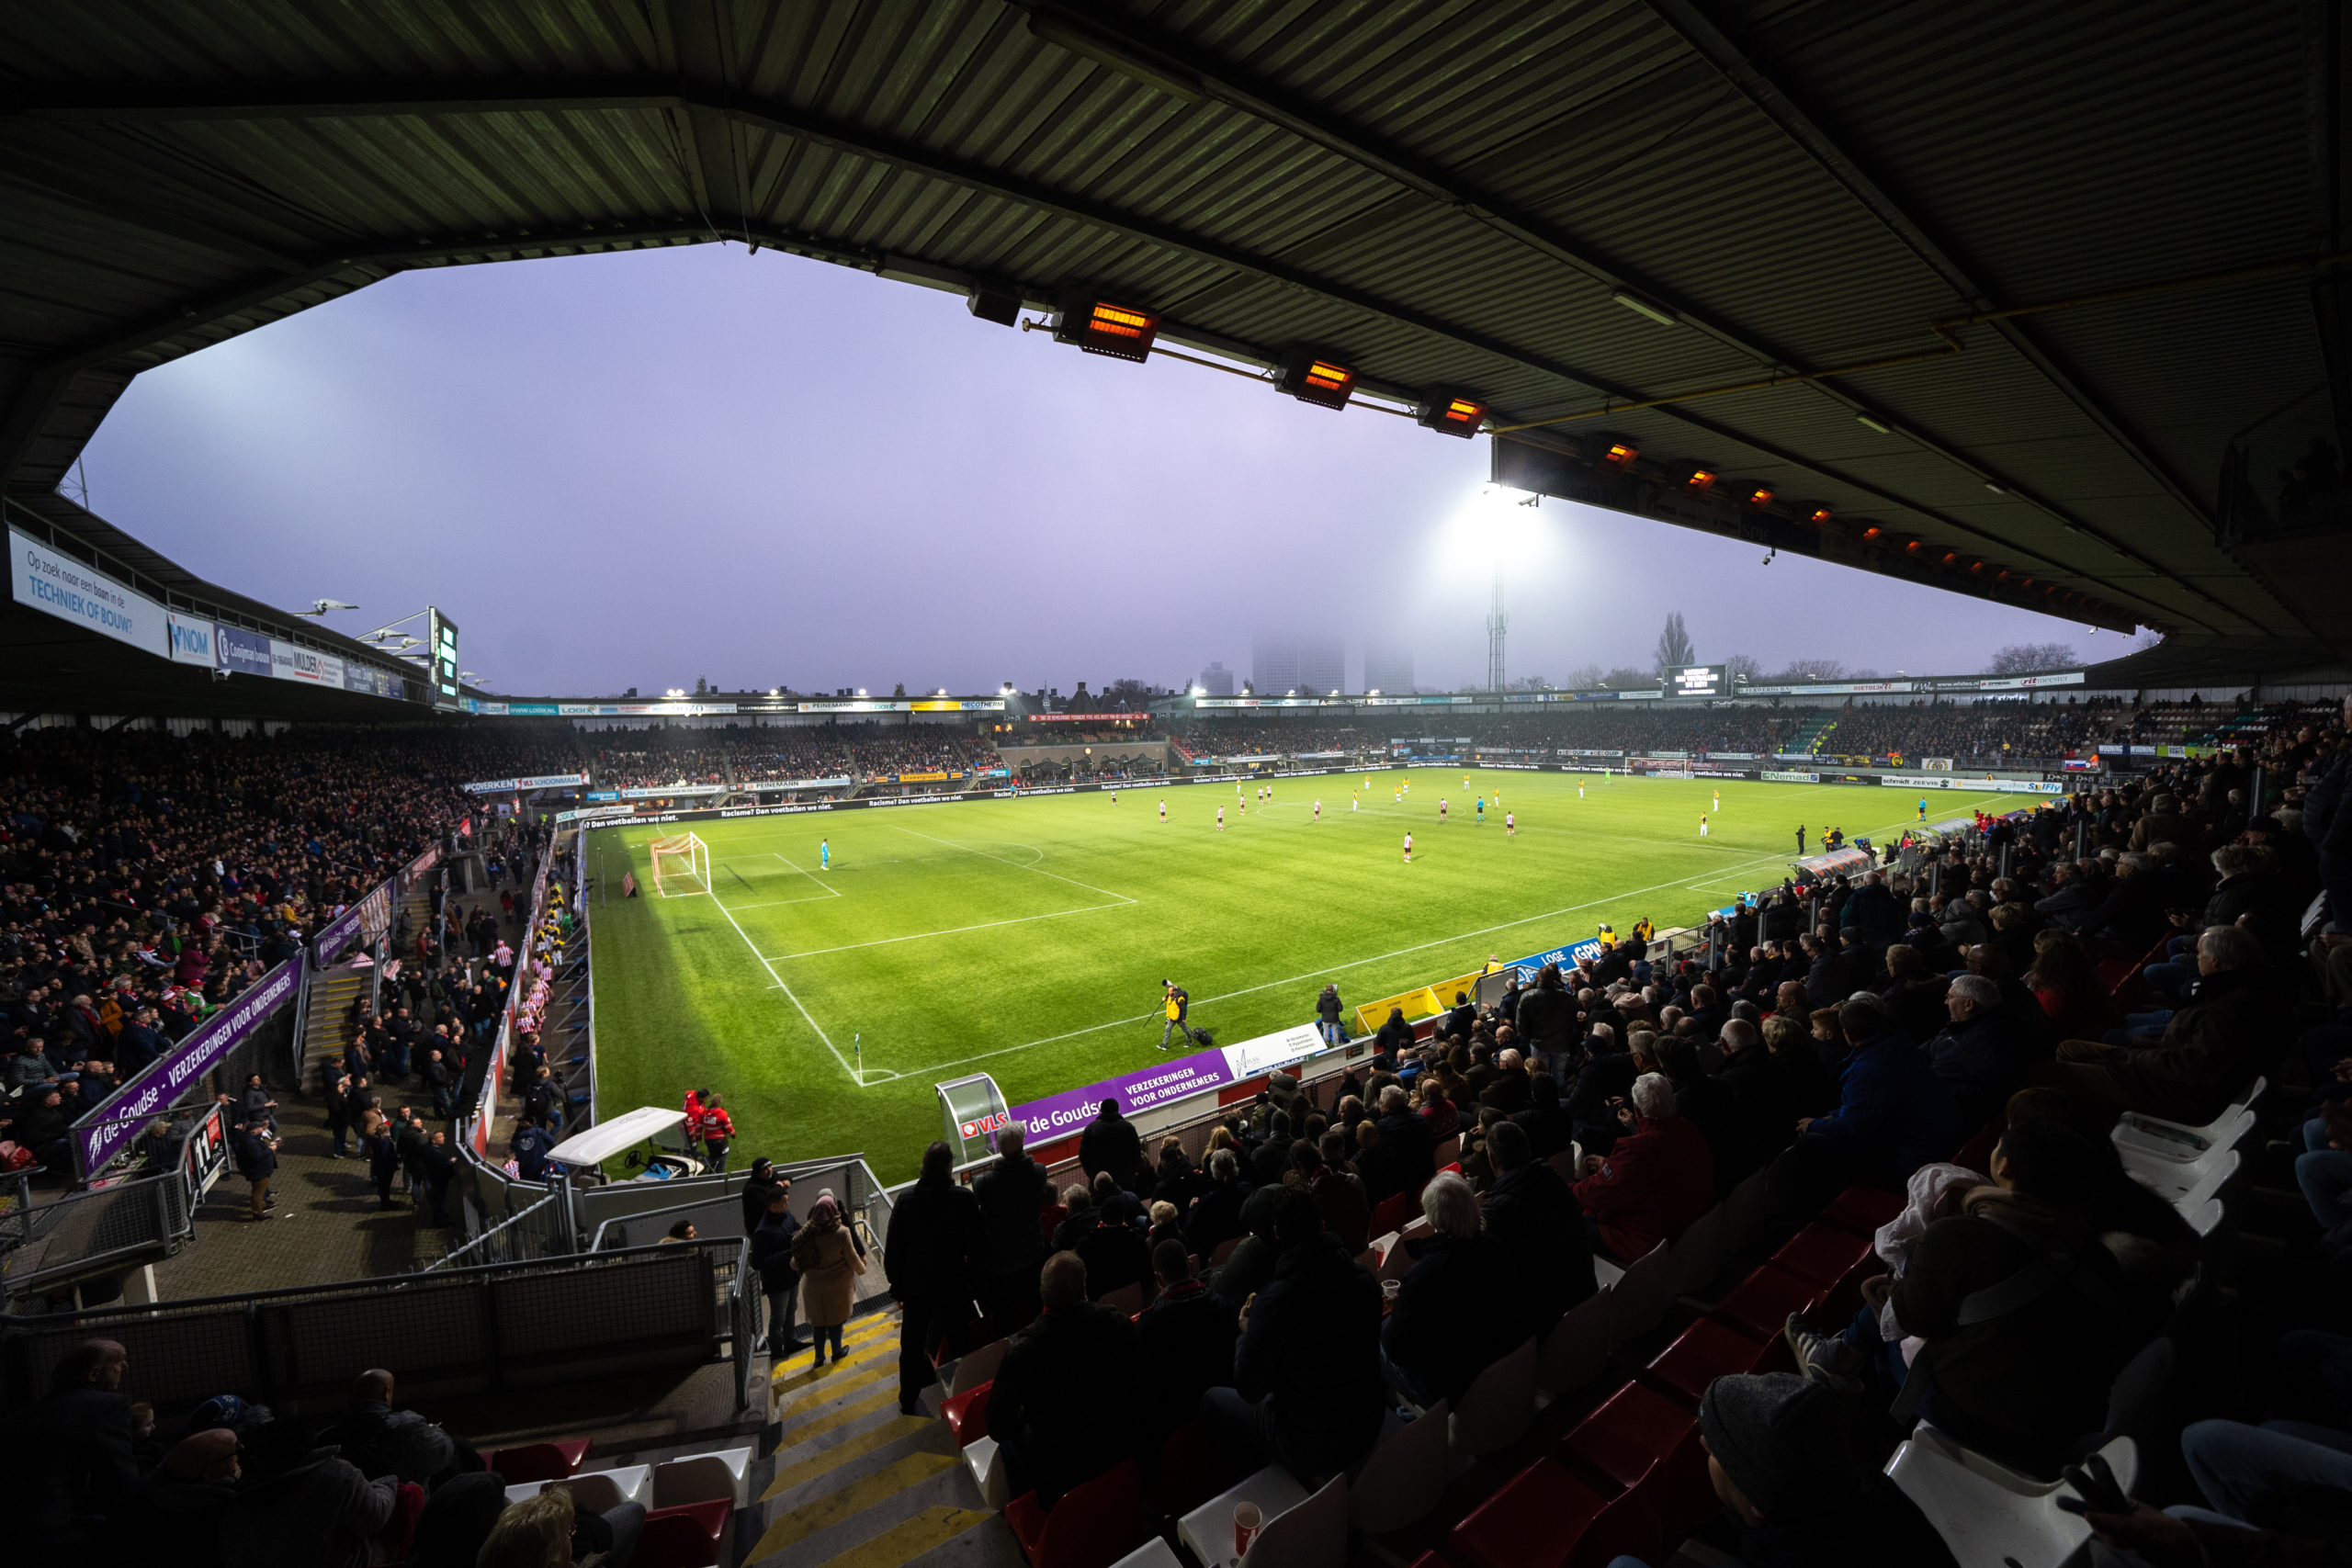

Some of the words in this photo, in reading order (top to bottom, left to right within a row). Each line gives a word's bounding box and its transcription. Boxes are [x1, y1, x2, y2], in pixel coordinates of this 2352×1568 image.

[28, 550, 40, 571] Op
[42, 559, 61, 578] zoek
[62, 570, 79, 587] naar
[80, 579, 93, 593] een
[94, 581, 109, 601] baan
[110, 590, 117, 604] in
[117, 593, 125, 608] de
[29, 575, 85, 615] TECHNIEK
[86, 602, 99, 619] OF
[101, 604, 132, 634] BOUW?
[184, 627, 209, 654] NOM
[294, 651, 317, 673] MULDER
[2023, 675, 2068, 686] ritmeester
[2098, 745, 2123, 753] WOONING
[2130, 745, 2156, 753] WOONING
[534, 777, 580, 785] SCHOONMAAK
[1770, 772, 1810, 782] Nemad
[869, 797, 898, 807] Racisme?
[910, 795, 941, 804] voetballen
[721, 808, 754, 818] Racisme?
[771, 806, 807, 814] voetballen
[591, 819, 605, 828] Dan
[606, 816, 647, 827] voetballen
[1540, 951, 1566, 965] LOGE
[104, 1118, 119, 1145] de
[119, 1087, 159, 1129] Goudse
[168, 1024, 232, 1088] VERZEKERINGEN
[232, 1006, 252, 1032] VOOR
[251, 974, 291, 1016] ONDERNEMERS
[1125, 1067, 1195, 1095] VERZEKERINGEN
[1129, 1091, 1157, 1107] VOOR
[1158, 1072, 1220, 1099] ONDERNEMERS
[978, 1112, 1007, 1134] VLS
[1030, 1116, 1050, 1134] de
